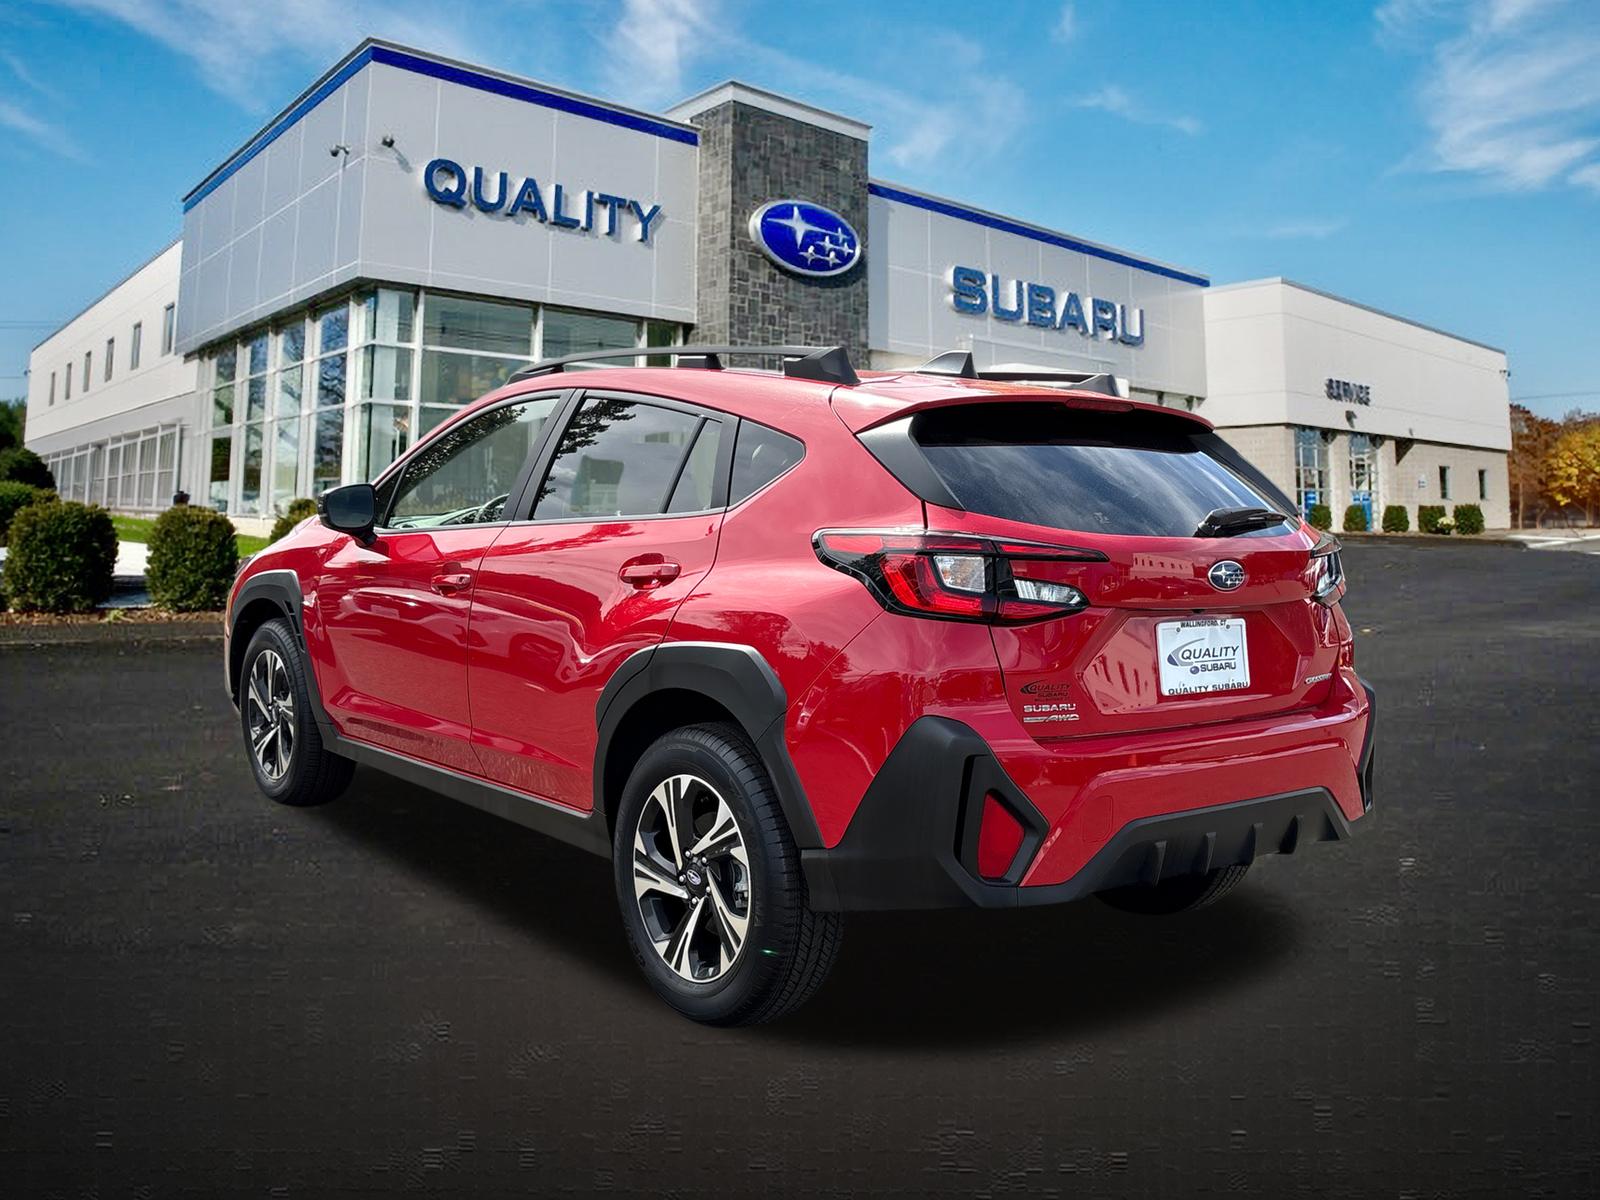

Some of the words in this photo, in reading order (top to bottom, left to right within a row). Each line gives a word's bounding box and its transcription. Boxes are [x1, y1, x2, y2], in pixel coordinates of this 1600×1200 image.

[424, 158, 662, 243] QUALITY
[950, 265, 1145, 346] SUBARU
[1181, 645, 1240, 661] QUALITY
[1200, 661, 1237, 673] SUBARU
[1029, 683, 1071, 692] QUALITY
[1168, 685, 1209, 696] QUALITY
[1212, 681, 1249, 692] SUBARU
[1023, 703, 1077, 713] SUBARU
